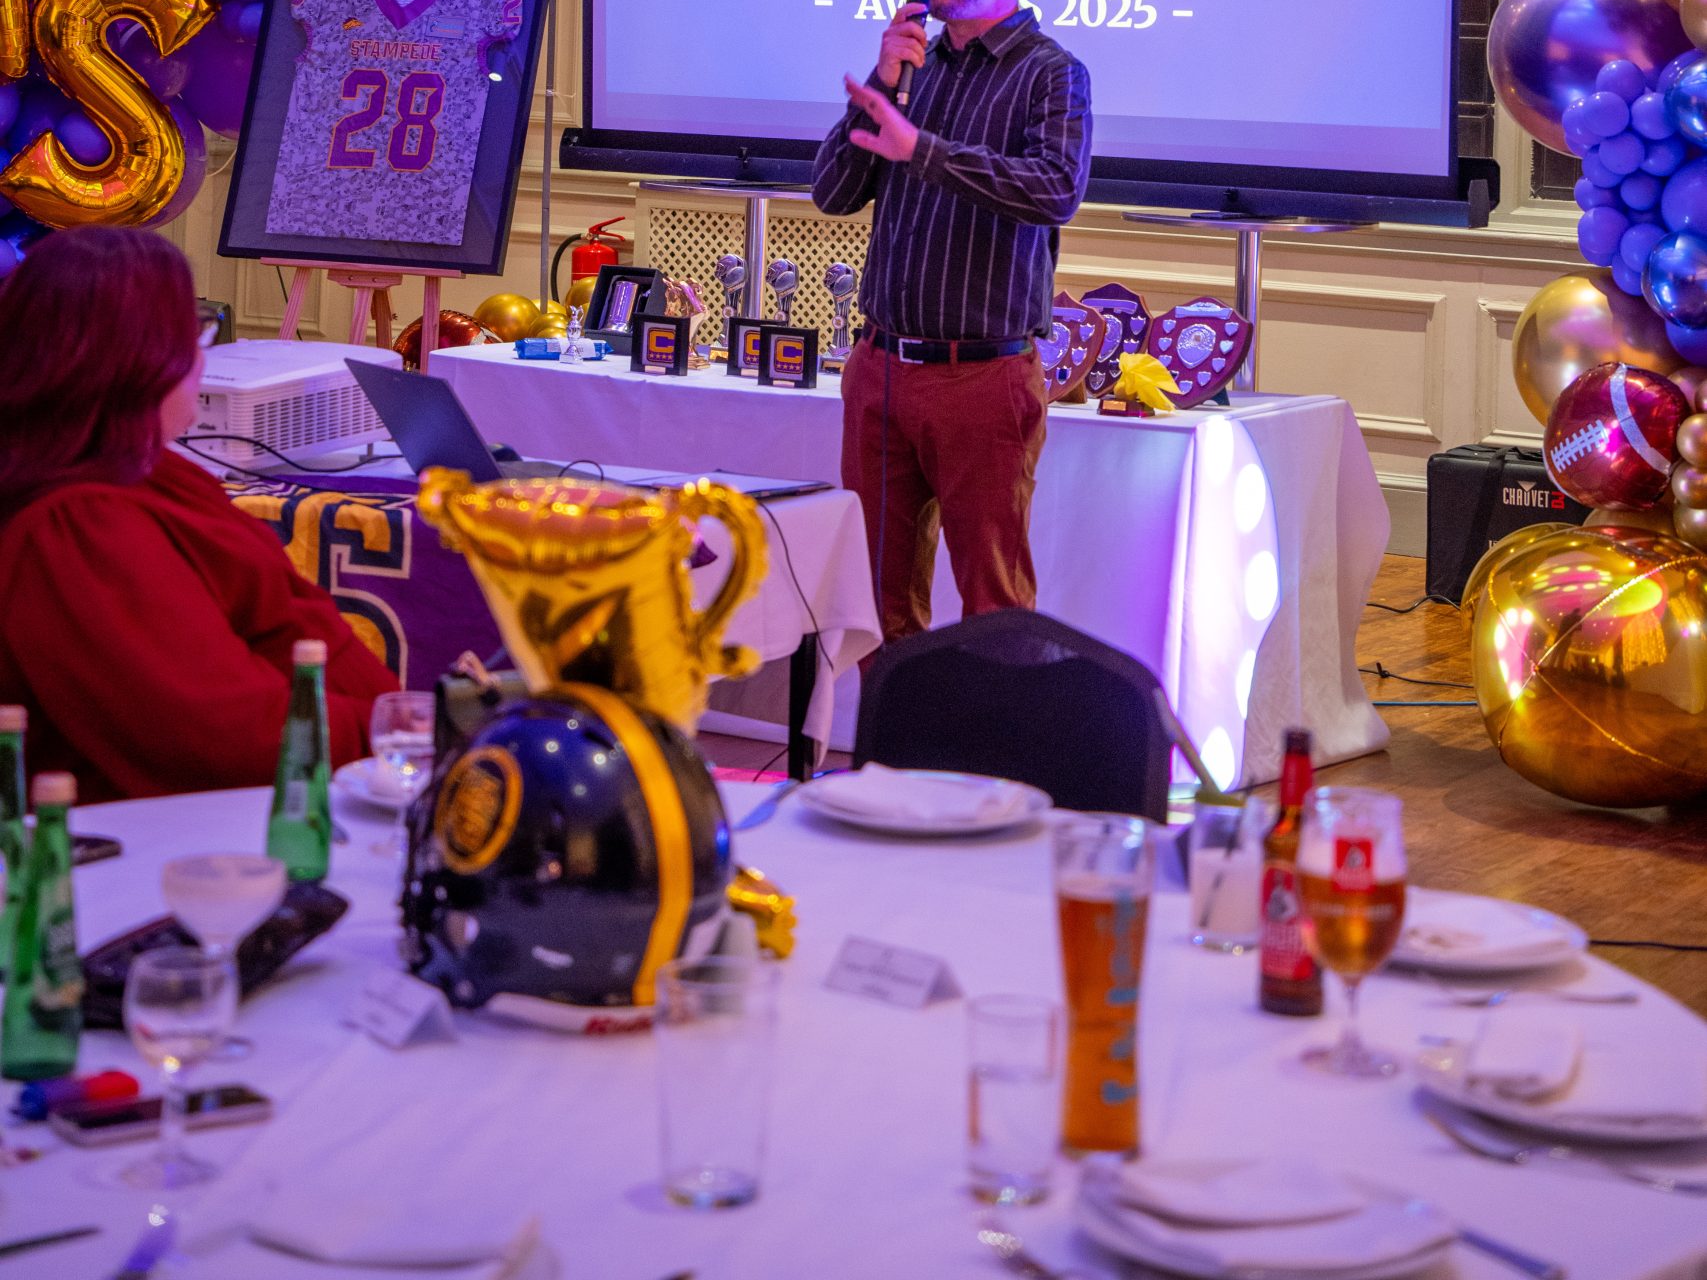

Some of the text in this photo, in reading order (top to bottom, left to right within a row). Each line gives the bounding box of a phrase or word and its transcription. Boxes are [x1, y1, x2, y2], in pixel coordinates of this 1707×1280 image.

[350, 39, 443, 62] STAMPEDE
[327, 67, 447, 172] 28
[1502, 487, 1550, 508] CHAUVET
